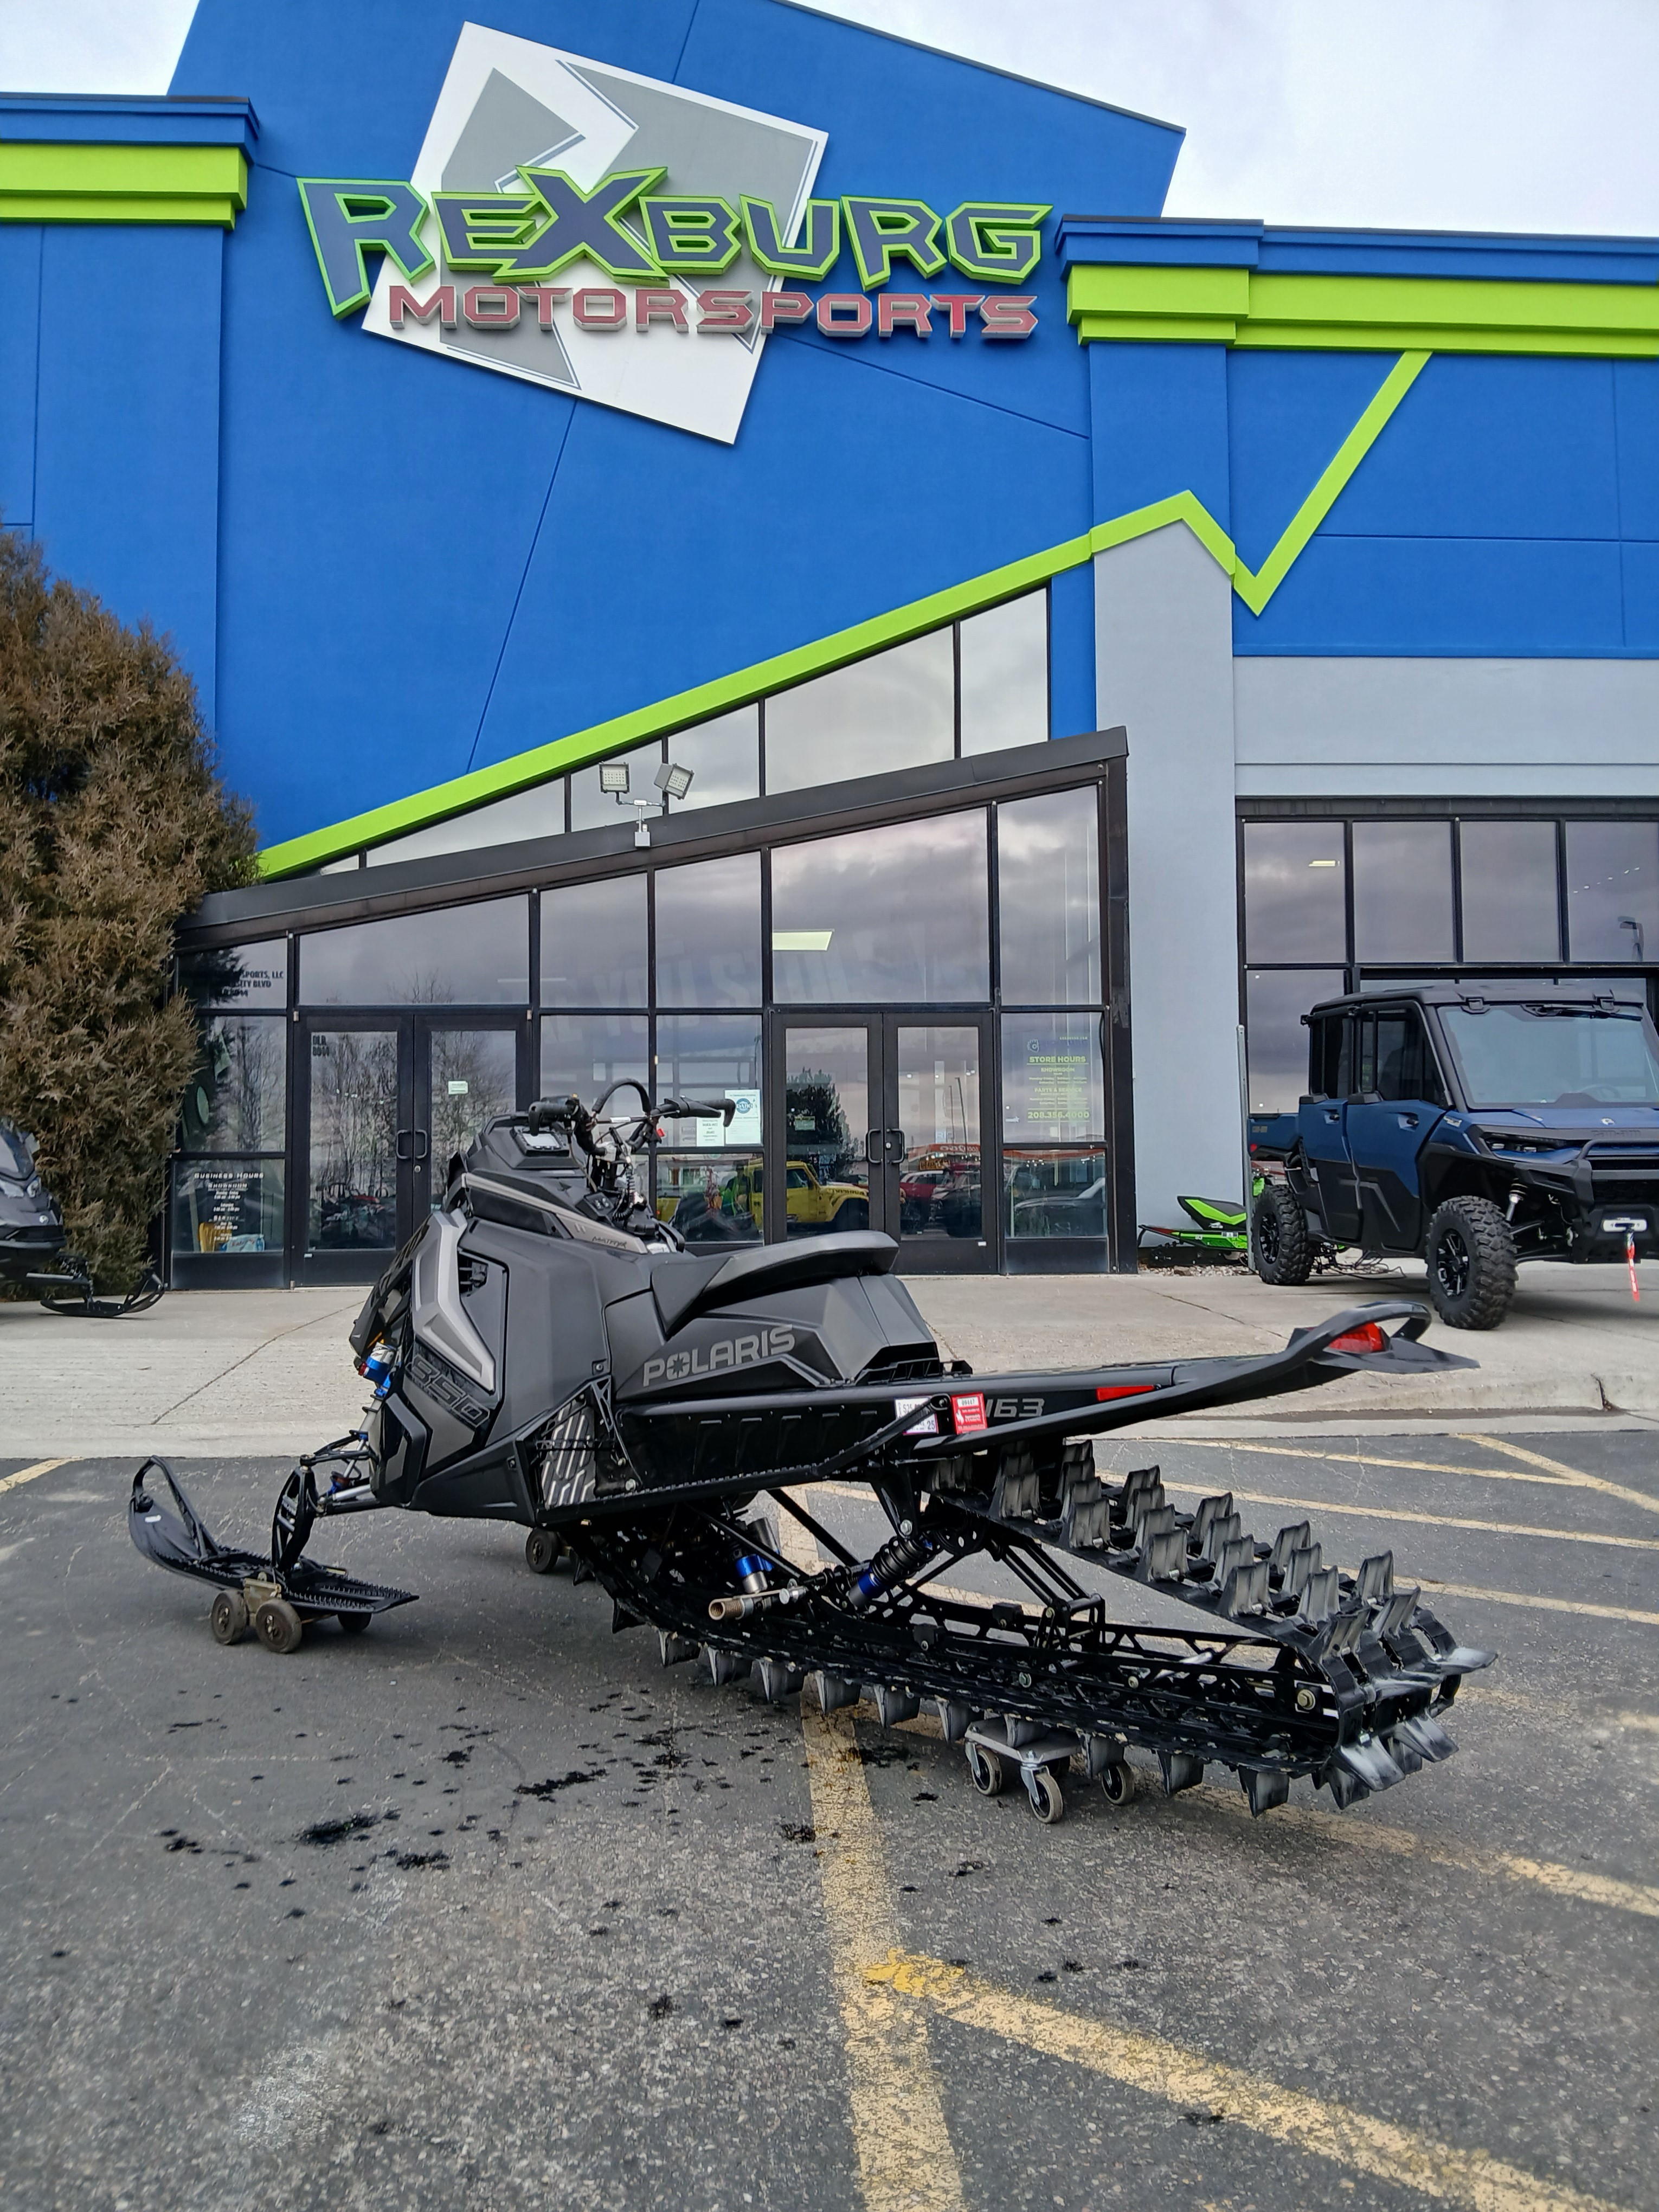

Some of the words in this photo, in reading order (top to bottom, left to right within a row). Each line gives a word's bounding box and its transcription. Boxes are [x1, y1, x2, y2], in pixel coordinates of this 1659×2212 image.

[295, 165, 1054, 318] REXBURG
[389, 286, 1039, 339] MOTORSPORTS
[643, 1324, 795, 1387] POLARIS
[405, 1354, 490, 1427] 850
[986, 1398, 1045, 1418] 163
[927, 1420, 936, 1430] 25
